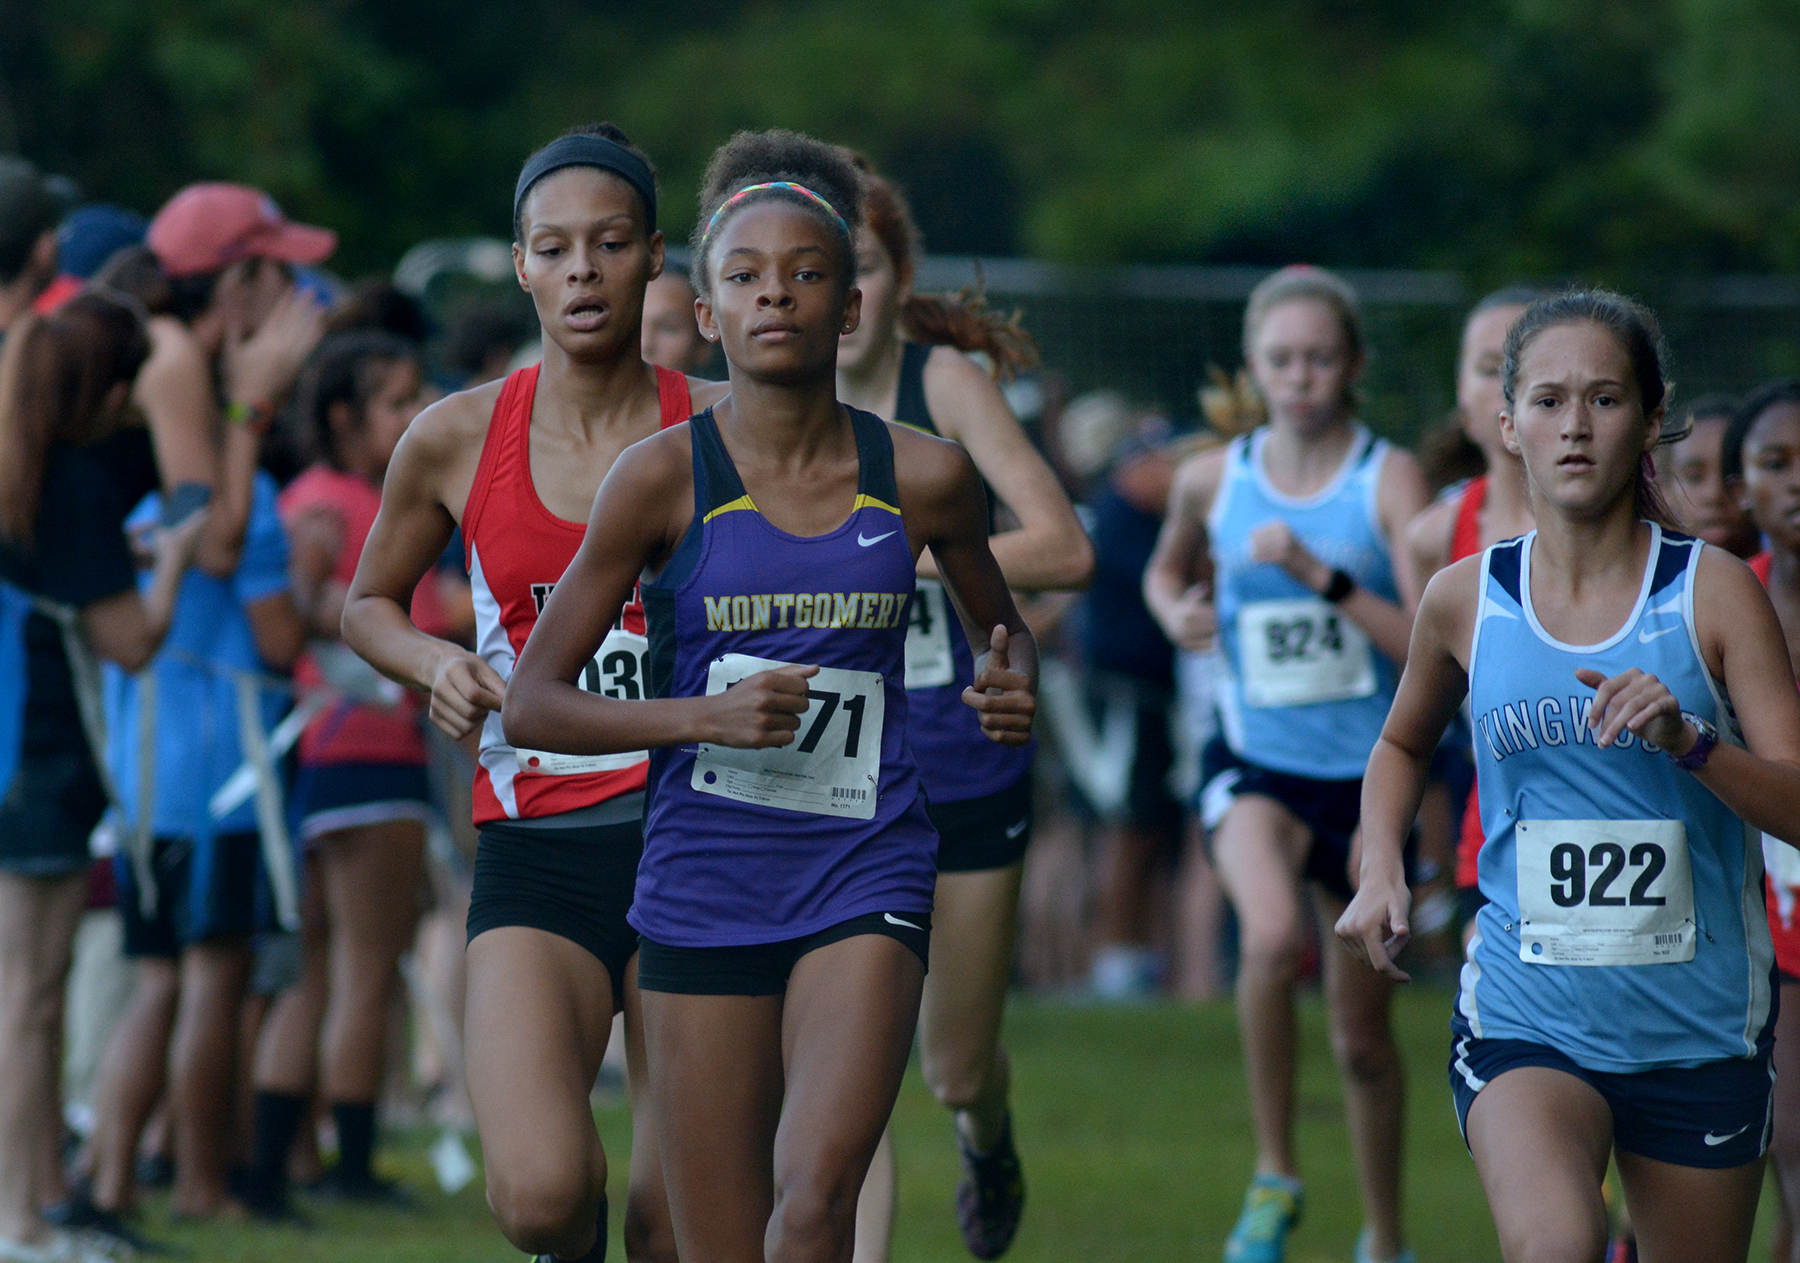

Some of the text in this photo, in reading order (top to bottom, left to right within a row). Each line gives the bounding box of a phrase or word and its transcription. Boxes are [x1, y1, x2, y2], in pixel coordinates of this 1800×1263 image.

[703, 592, 908, 631] MONTGOMERY
[726, 678, 867, 759] 71
[1549, 842, 1667, 908] 922
